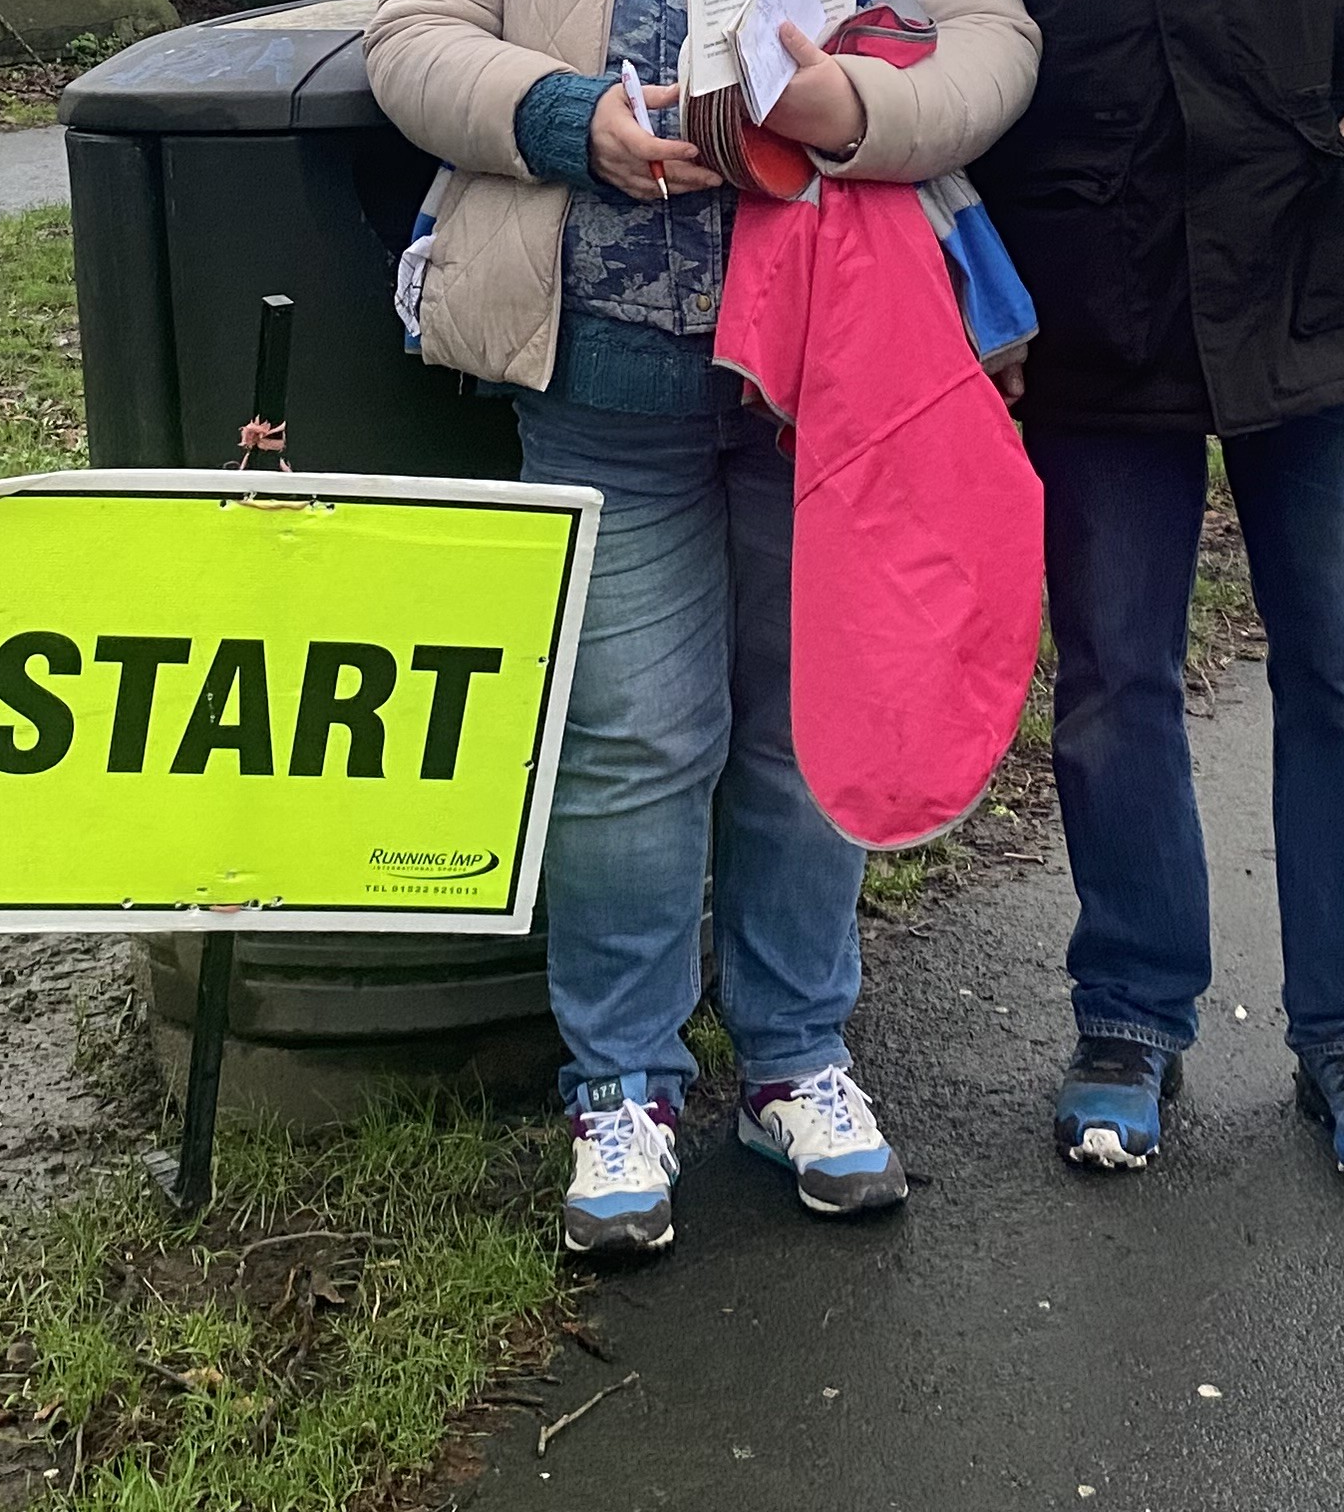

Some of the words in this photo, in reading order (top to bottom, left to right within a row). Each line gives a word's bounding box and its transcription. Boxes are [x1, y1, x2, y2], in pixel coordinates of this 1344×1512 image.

[369, 848, 447, 865] RUNNING
[450, 850, 483, 866] IMP
[365, 884, 387, 892] TEL
[433, 886, 478, 895] 521013
[592, 1082, 617, 1101] 577
